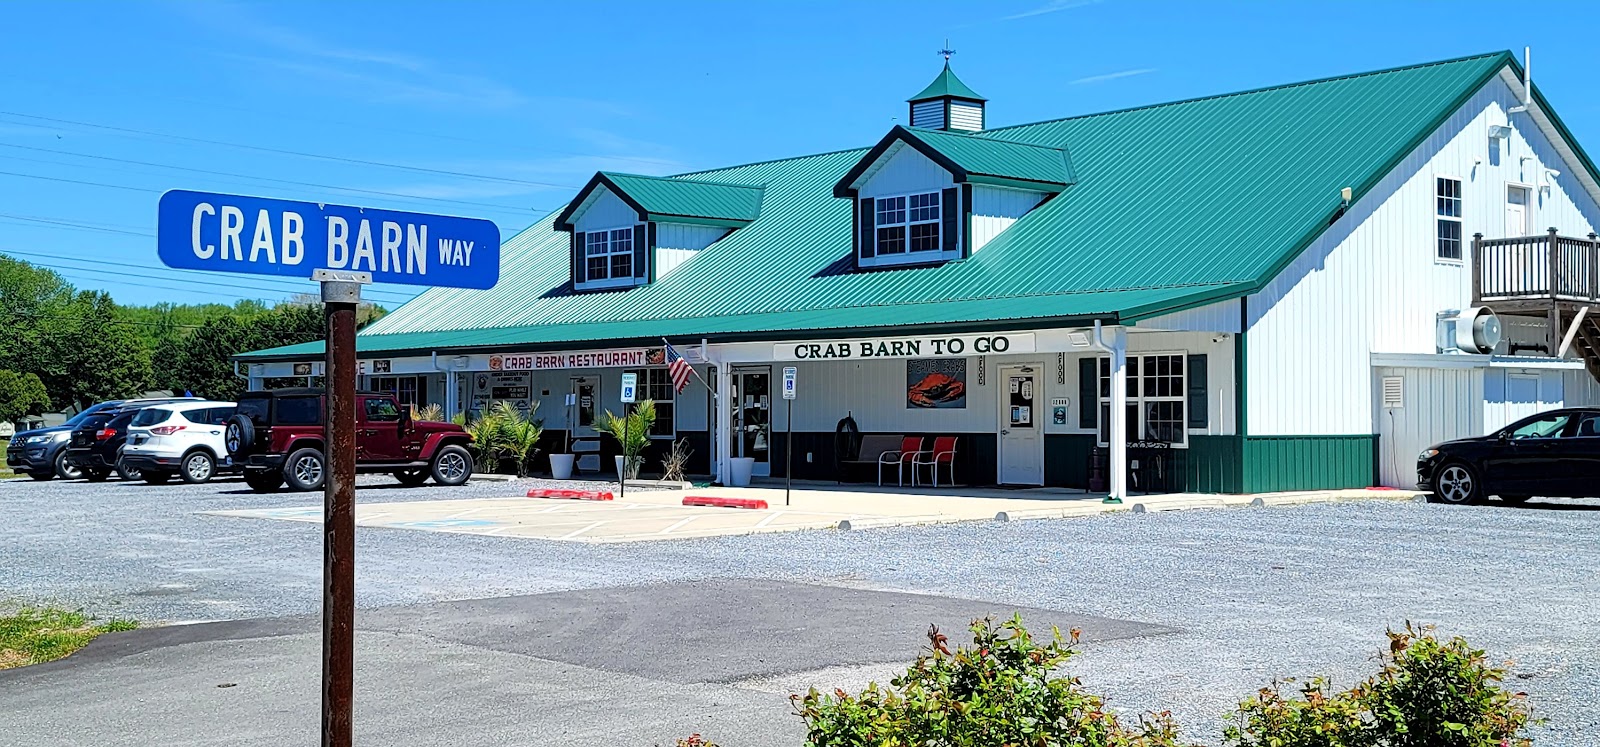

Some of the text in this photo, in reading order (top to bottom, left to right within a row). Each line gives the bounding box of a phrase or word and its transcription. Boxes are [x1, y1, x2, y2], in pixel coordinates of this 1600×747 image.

[191, 202, 474, 275] CRAB BARN WAY
[794, 336, 1009, 359] CRAB BARN TO GO
[505, 351, 643, 369] CRAB BARN RESTAURANT
